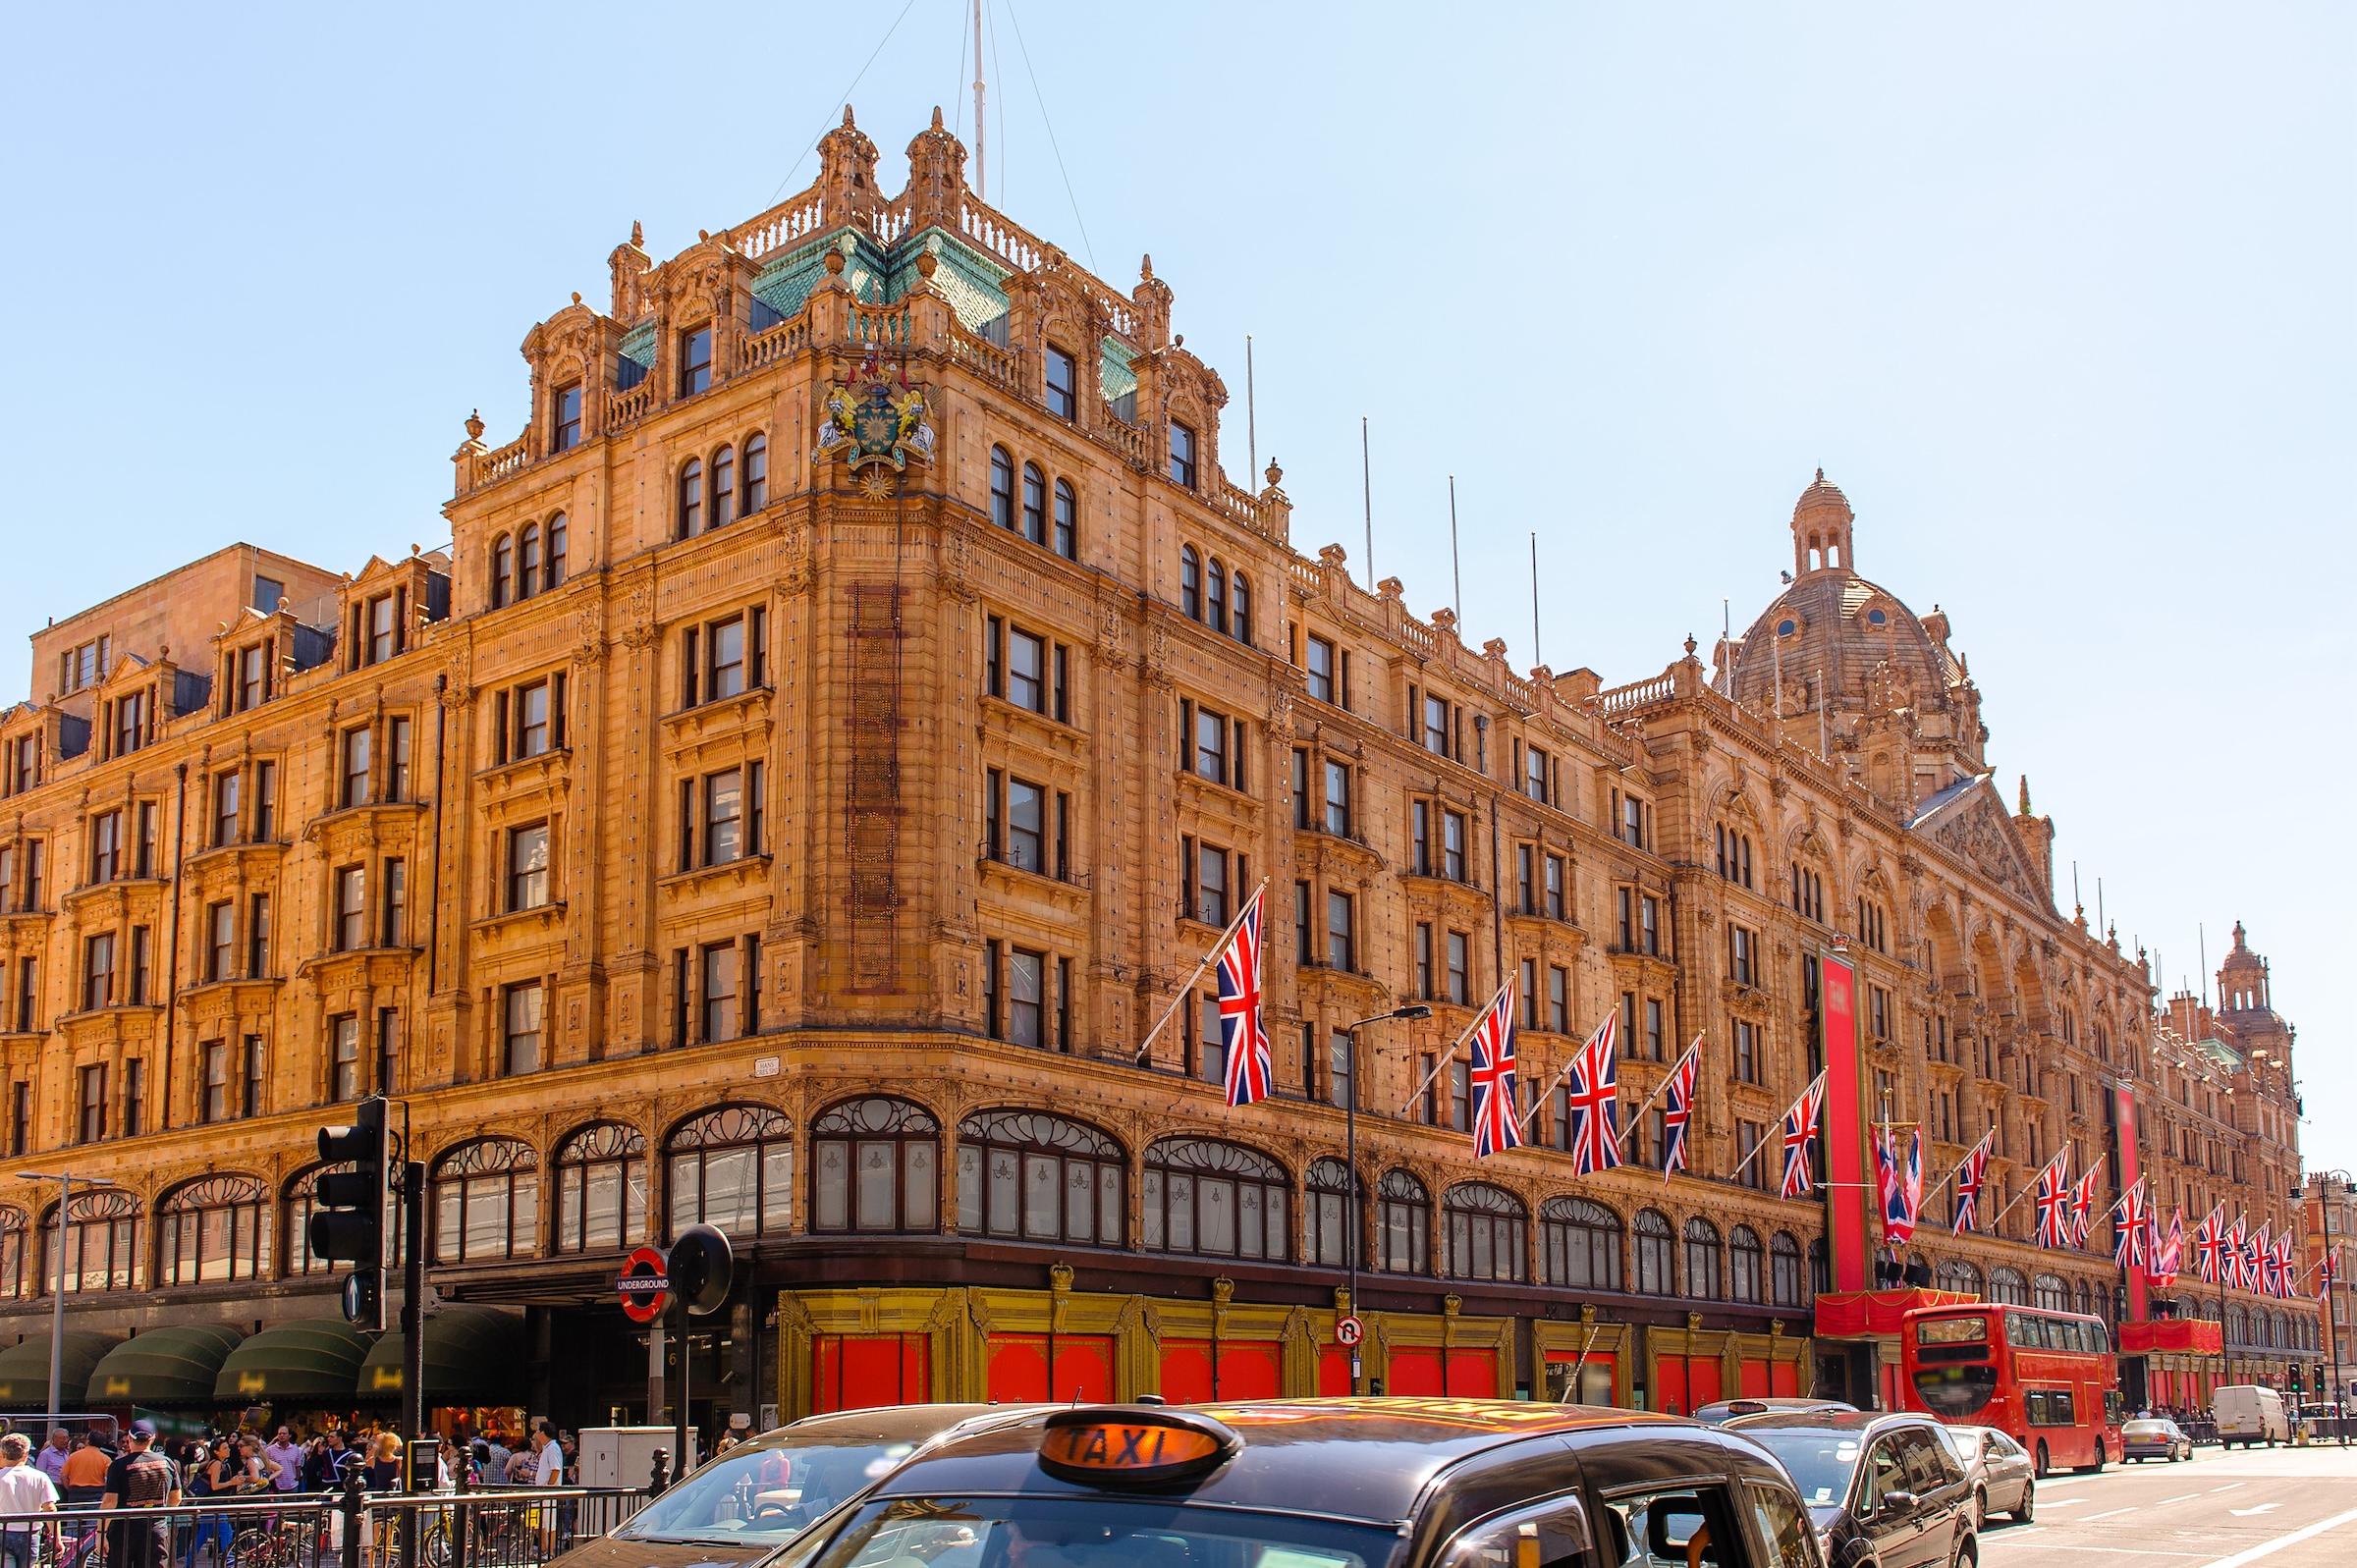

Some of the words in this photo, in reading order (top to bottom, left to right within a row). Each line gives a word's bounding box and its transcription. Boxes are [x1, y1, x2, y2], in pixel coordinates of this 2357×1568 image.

[618, 1278, 669, 1290] UNDERGROUND
[669, 1352, 677, 1366] 6
[1068, 1428, 1166, 1464] TAXI
